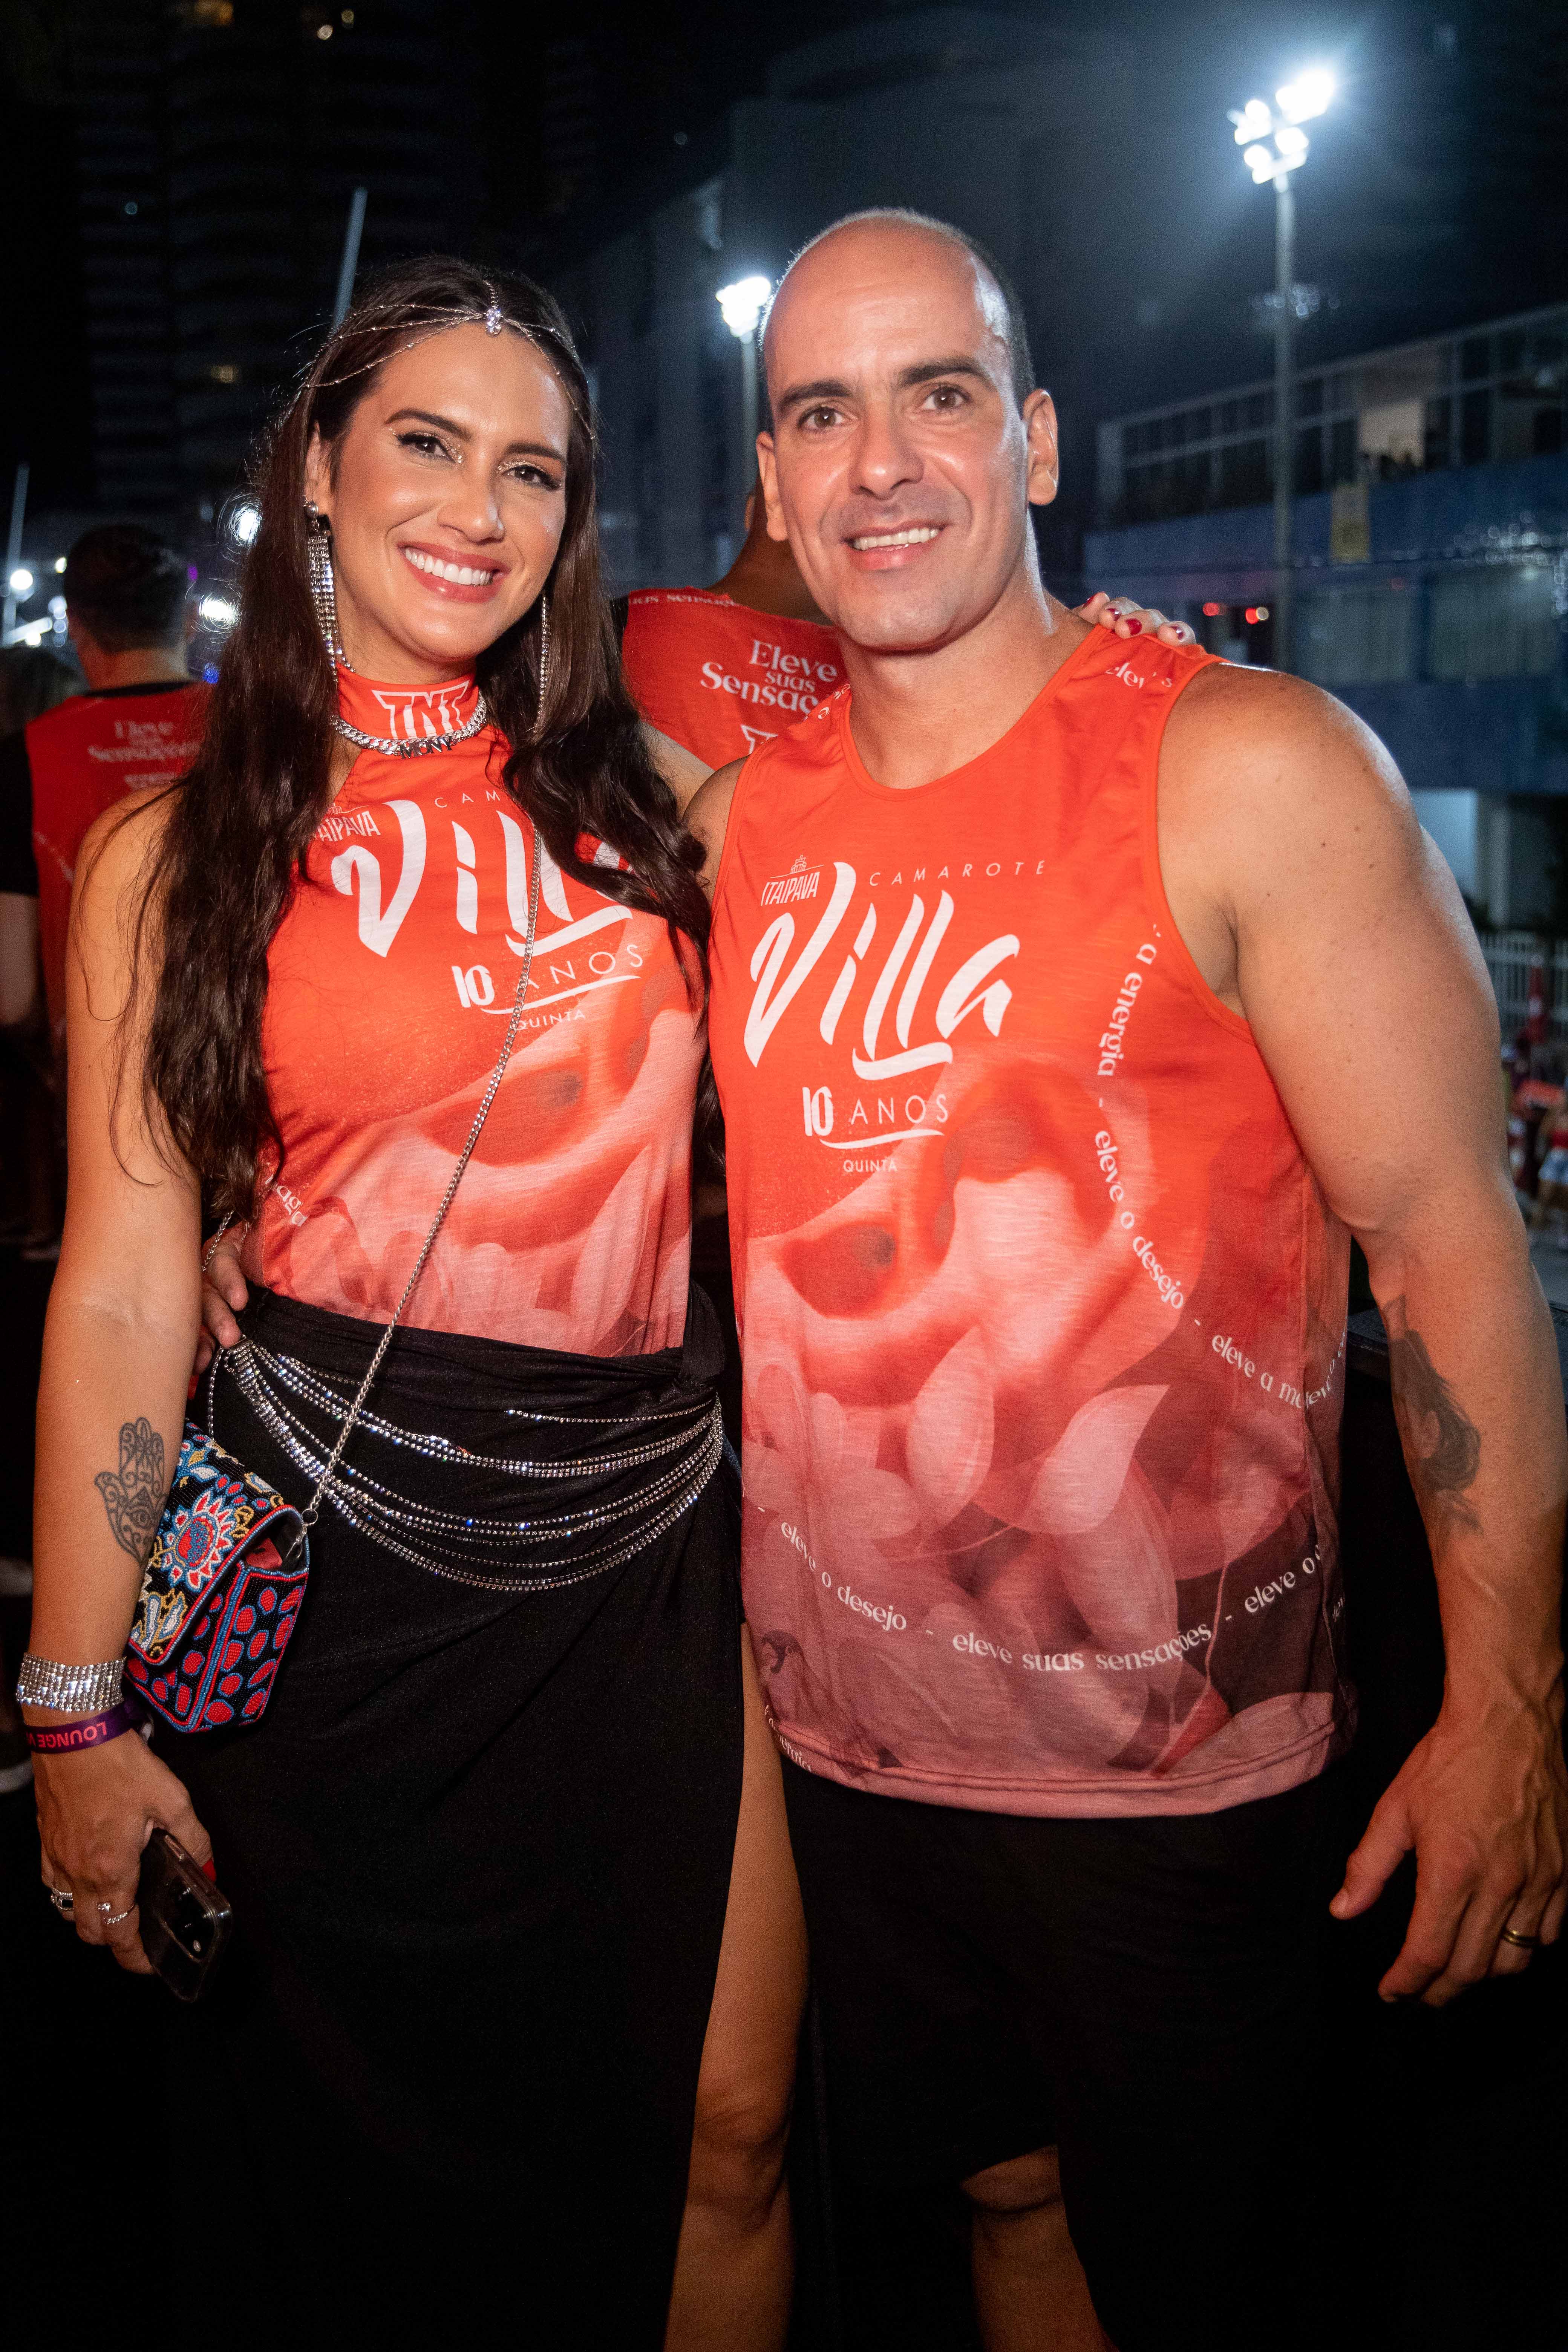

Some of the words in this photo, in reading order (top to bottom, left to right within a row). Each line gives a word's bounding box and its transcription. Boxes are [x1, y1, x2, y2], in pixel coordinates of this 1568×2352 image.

[749, 640, 837, 682] Eleve
[765, 670, 816, 693] suas
[372, 680, 470, 740] TNT
[314, 811, 381, 842] AIPAVA
[761, 871, 821, 906] ITAIPAVA
[869, 860, 1045, 887] CAMAROTE
[744, 862, 1020, 1080] Villa
[1136, 943, 1157, 965] a
[452, 965, 495, 1008] 10
[516, 944, 643, 992] ANOS
[514, 1009, 585, 1031] QUINTA
[1097, 972, 1143, 1076] energia
[802, 1085, 834, 1136] 10
[851, 1094, 949, 1125] ANOS
[843, 1159, 898, 1173] QUINTA
[1095, 1130, 1124, 1203] eleve
[1120, 1211, 1135, 1230] o
[1132, 1236, 1184, 1309] desejo
[1211, 1335, 1256, 1378] eleve
[1260, 1372, 1274, 1392] a
[781, 1522, 816, 1571] eleve
[821, 1571, 831, 1589] o
[837, 1585, 907, 1631] desejo
[952, 1632, 1013, 1664] eleve
[1023, 1651, 1084, 1671] suas
[1244, 1571, 1296, 1613] eleve
[1302, 1557, 1315, 1574] o
[36, 1721, 107, 1748] LOUNGE
